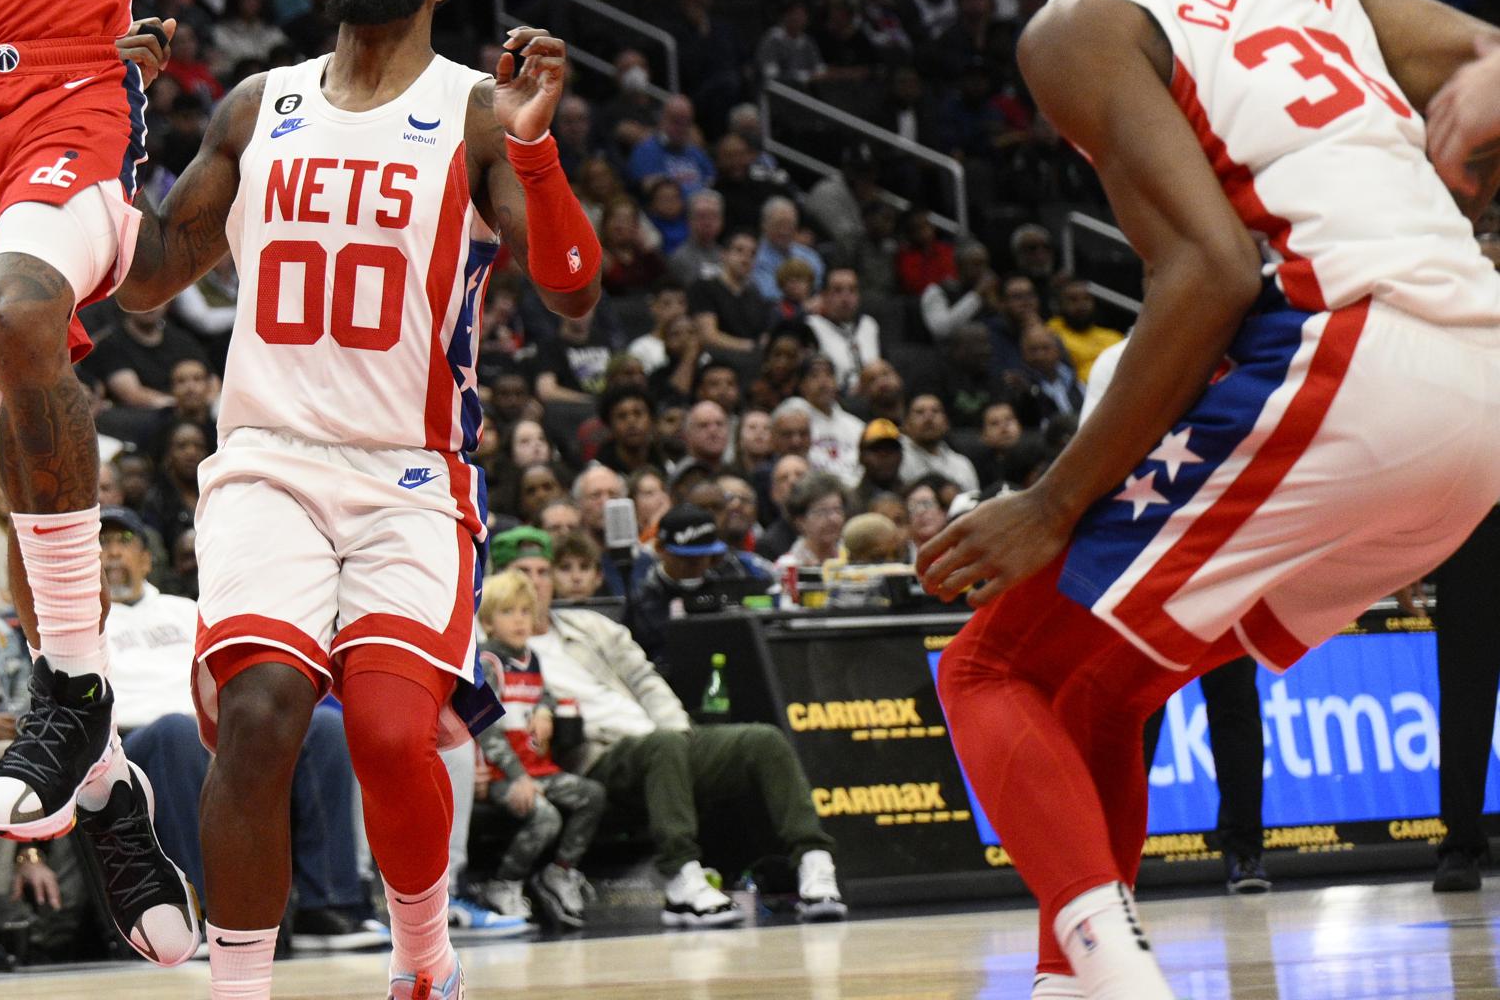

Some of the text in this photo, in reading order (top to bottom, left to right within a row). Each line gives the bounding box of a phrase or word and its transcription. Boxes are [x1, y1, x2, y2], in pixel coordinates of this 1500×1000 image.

[281, 97, 298, 114] 6
[278, 117, 305, 129] NIKE
[403, 132, 436, 145] Webull
[264, 157, 418, 230] NETS
[256, 240, 408, 352] 00
[404, 468, 430, 481] NIKE
